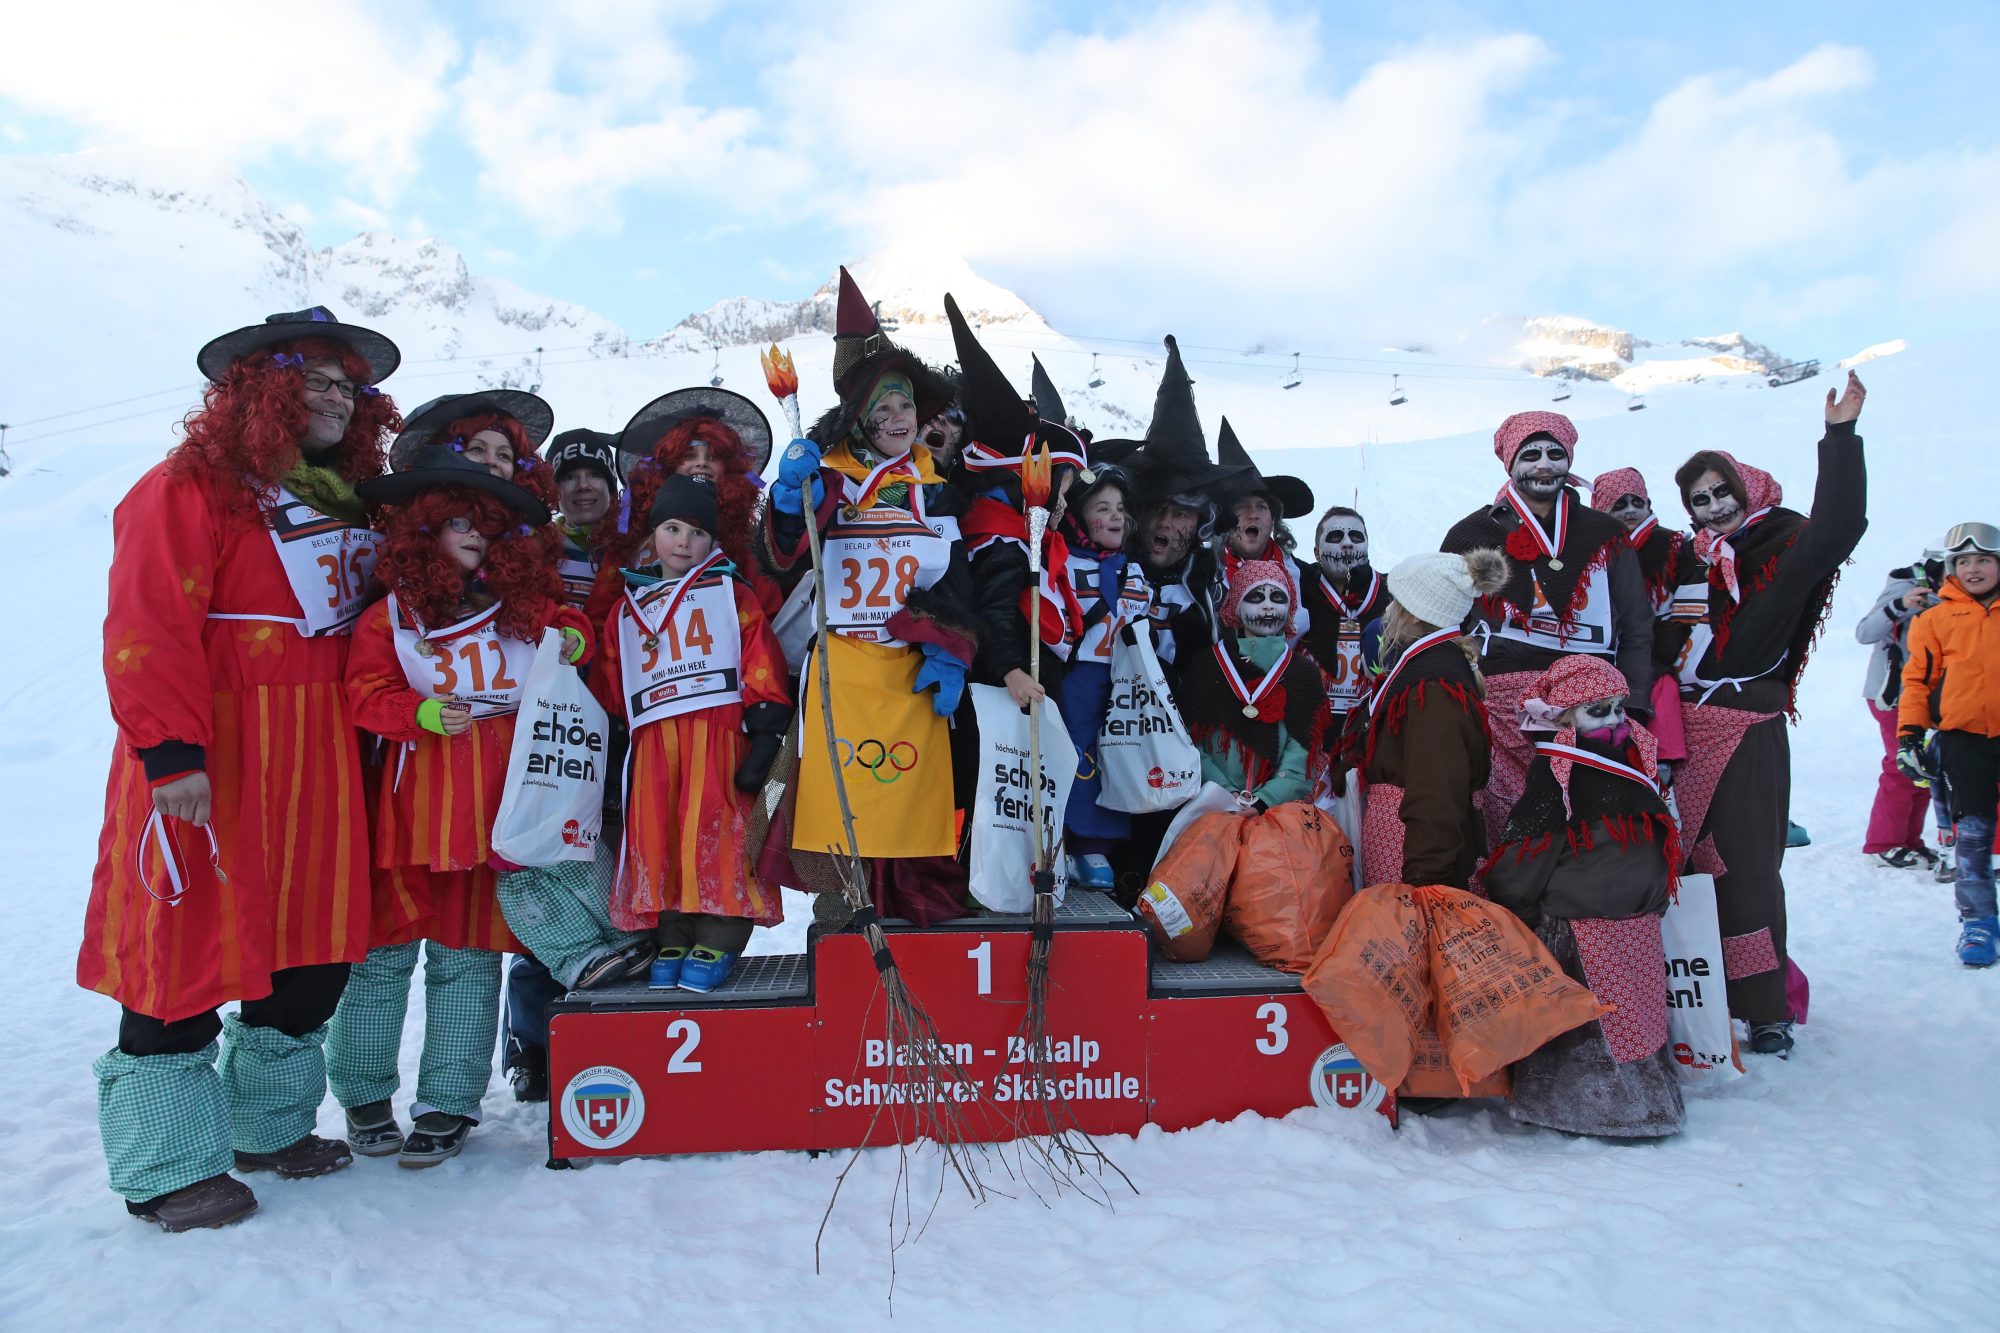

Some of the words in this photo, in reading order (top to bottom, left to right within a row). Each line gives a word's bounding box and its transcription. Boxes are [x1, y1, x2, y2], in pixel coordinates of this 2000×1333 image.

[312, 535, 340, 549] BELALP
[352, 532, 372, 542] HEXE
[844, 543, 872, 551] BELALP
[891, 540, 911, 548] HEXE
[316, 547, 372, 609] 315
[840, 555, 920, 609] 328
[480, 624, 497, 635] HEX
[851, 611, 889, 622] MINI-MAXI
[638, 608, 714, 674] 314
[431, 639, 518, 694] 312
[651, 664, 687, 682] MINI-MAXI
[688, 660, 707, 670] HEXE
[658, 685, 676, 699] Wallis
[552, 703, 567, 711] zeit
[570, 703, 581, 713] für
[1019, 749, 1030, 759] zeit
[994, 786, 1056, 827] ferien
[967, 941, 992, 995] 1
[1471, 944, 1501, 966] LITER
[1255, 1002, 1289, 1056] 3
[666, 1019, 702, 1075] 2
[1007, 1034, 1100, 1068] Belalp
[571, 1067, 602, 1088] SCHWEIZER
[603, 1067, 634, 1087] SKISCHULE
[825, 1077, 984, 1107] Schweizer
[993, 1071, 1140, 1101] Skischule
